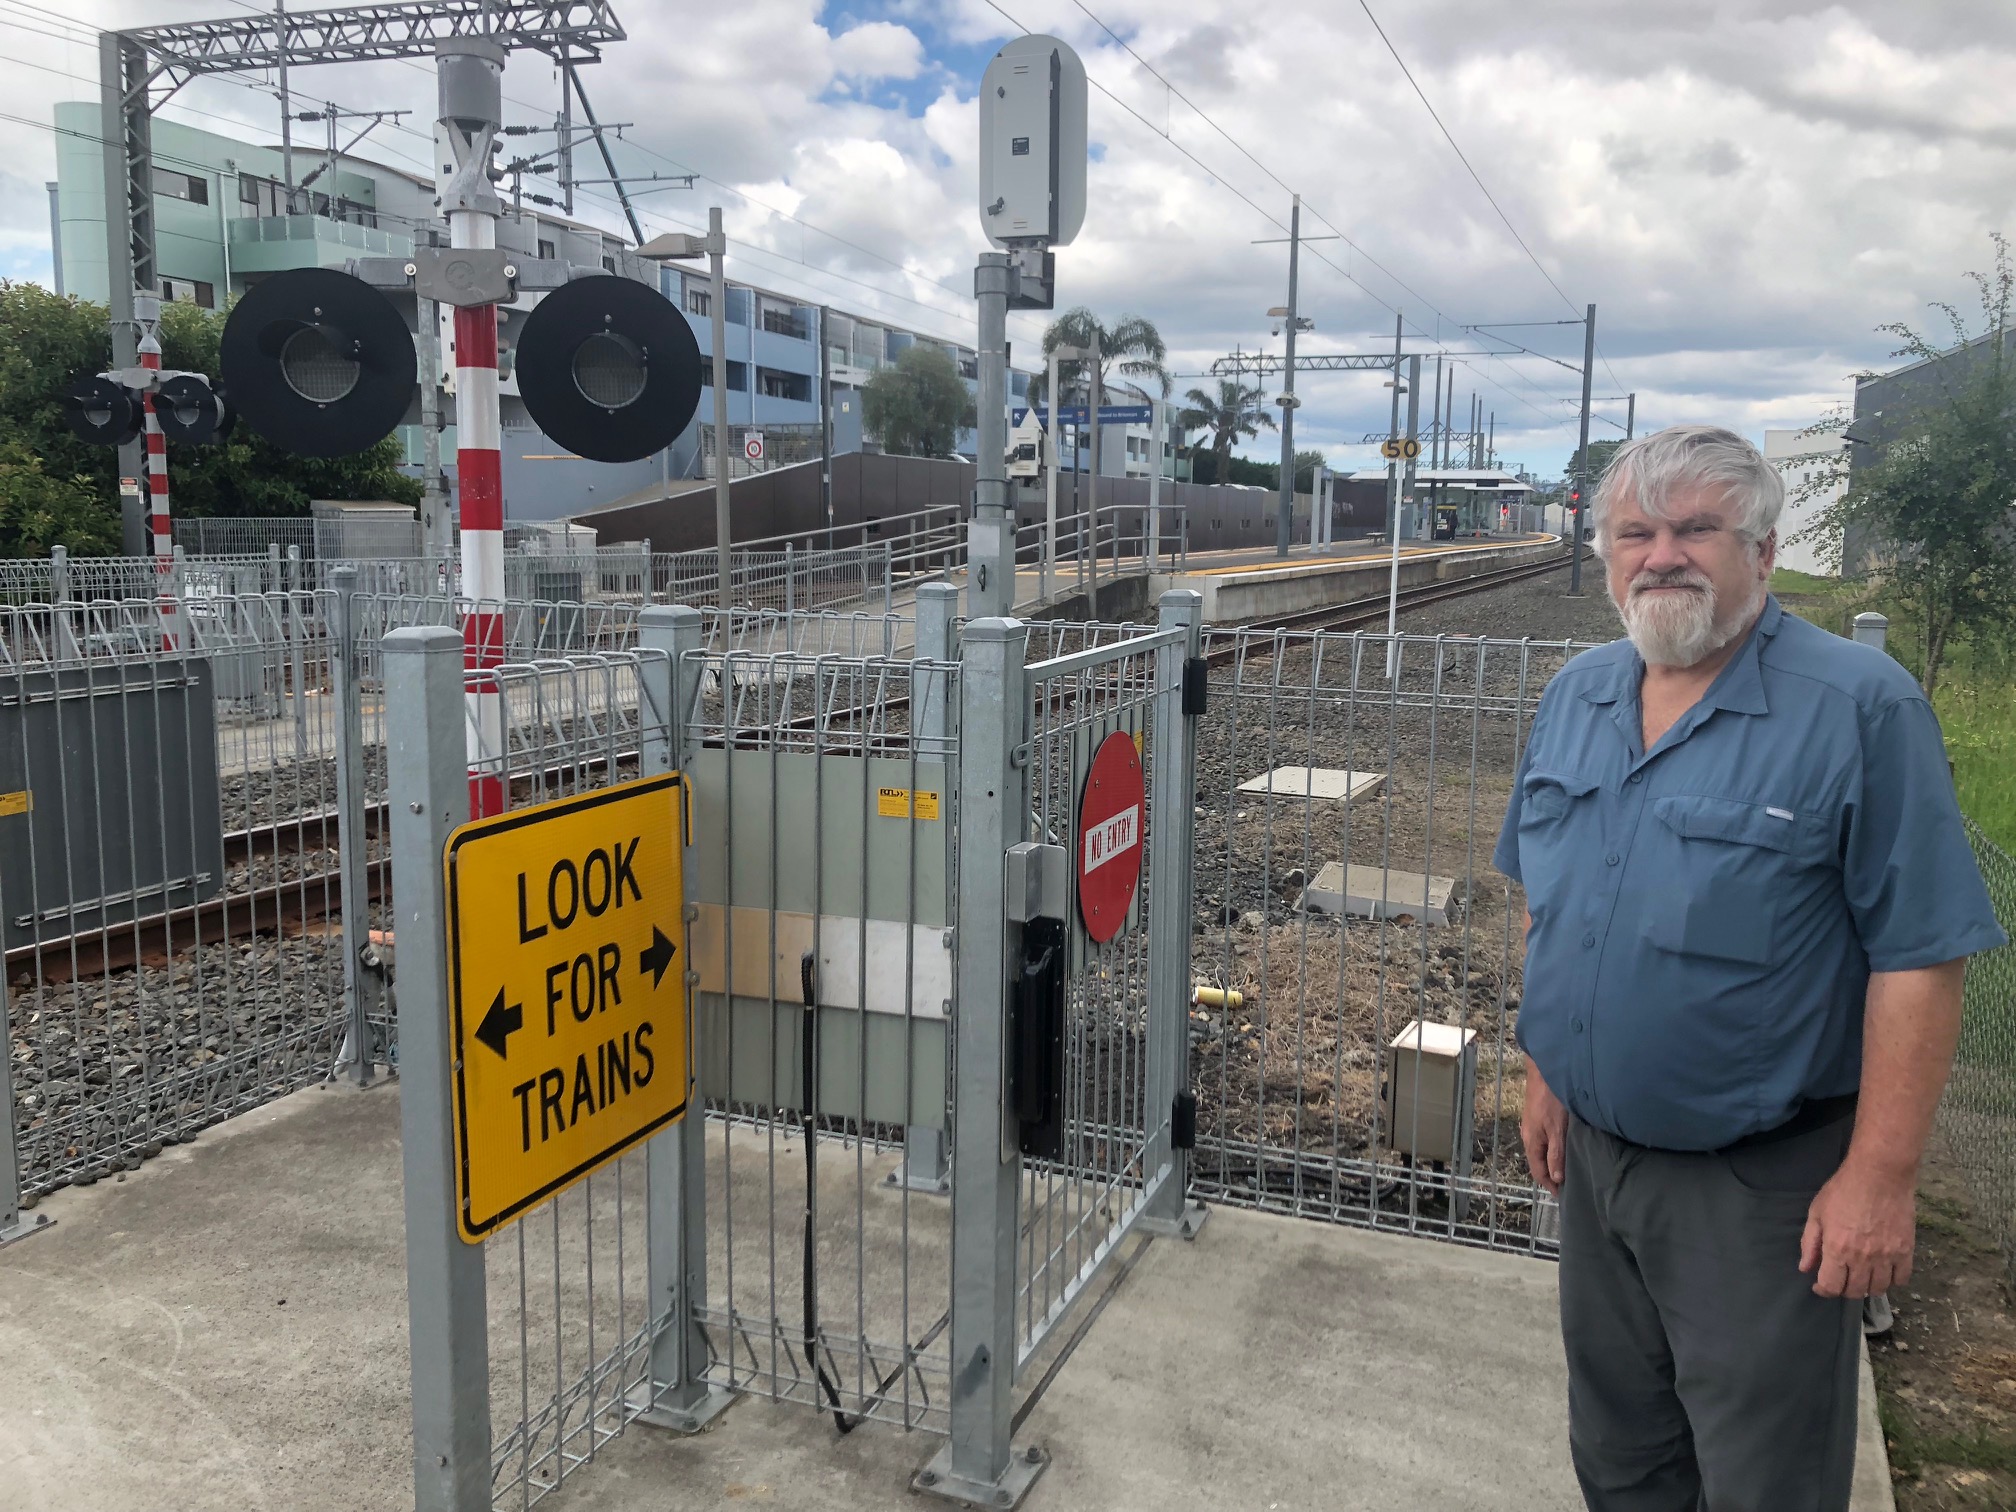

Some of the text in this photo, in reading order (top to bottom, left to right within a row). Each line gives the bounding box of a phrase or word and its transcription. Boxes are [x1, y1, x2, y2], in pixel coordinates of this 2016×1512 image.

[1387, 440, 1417, 458] 50
[1091, 814, 1131, 863] NO ENTRY
[517, 836, 642, 944] LOOK
[546, 942, 621, 1037] FOR
[512, 1021, 654, 1152] TRAINS
